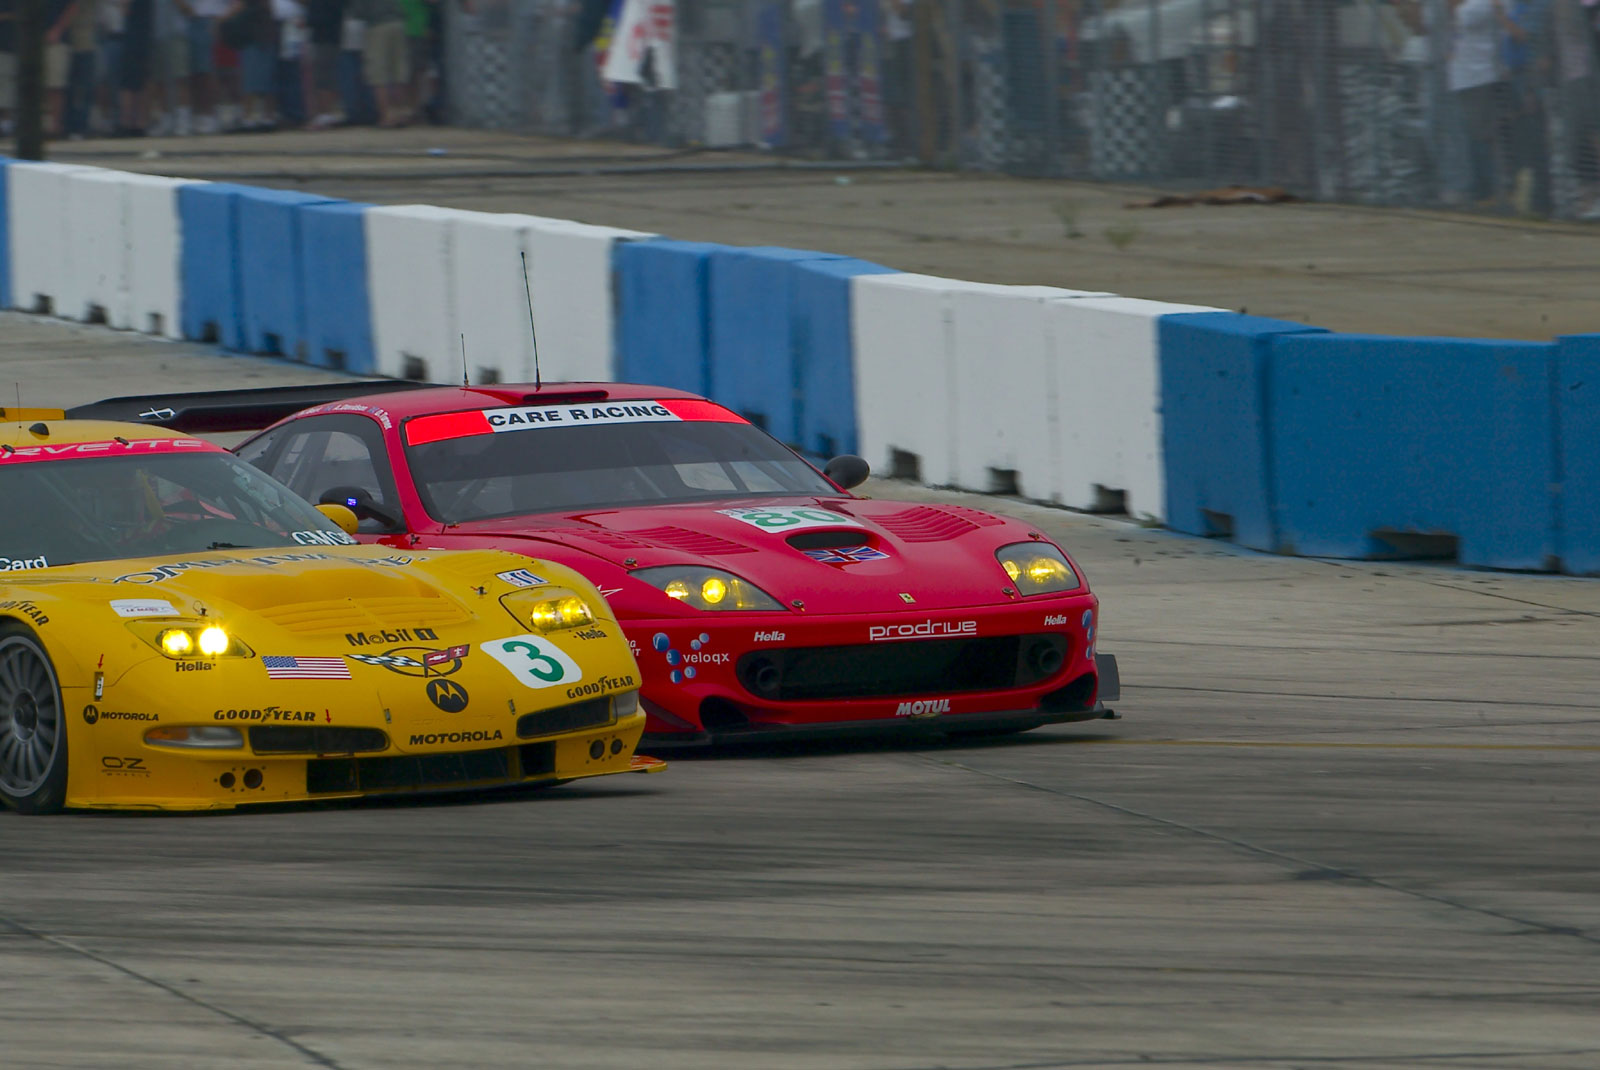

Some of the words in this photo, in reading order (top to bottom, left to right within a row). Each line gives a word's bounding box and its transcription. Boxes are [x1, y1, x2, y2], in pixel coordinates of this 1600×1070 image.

[488, 410, 562, 426] CARE
[569, 405, 670, 420] RACING
[0, 439, 202, 459] RVETTE
[742, 510, 847, 527] 80
[1044, 614, 1067, 626] Hella
[345, 628, 413, 647] Mobil
[576, 629, 608, 640] Hella
[754, 631, 786, 642] Hella
[869, 619, 977, 641] prodrive
[175, 661, 216, 672] Hella
[502, 641, 565, 682] 3
[683, 652, 730, 665] veloqx
[567, 676, 635, 699] GOODYEAR
[213, 706, 317, 723] GOODYEAR
[896, 699, 951, 716] MOTUL
[101, 711, 160, 722] MOTOROLA
[409, 729, 504, 746] MOTOROLA
